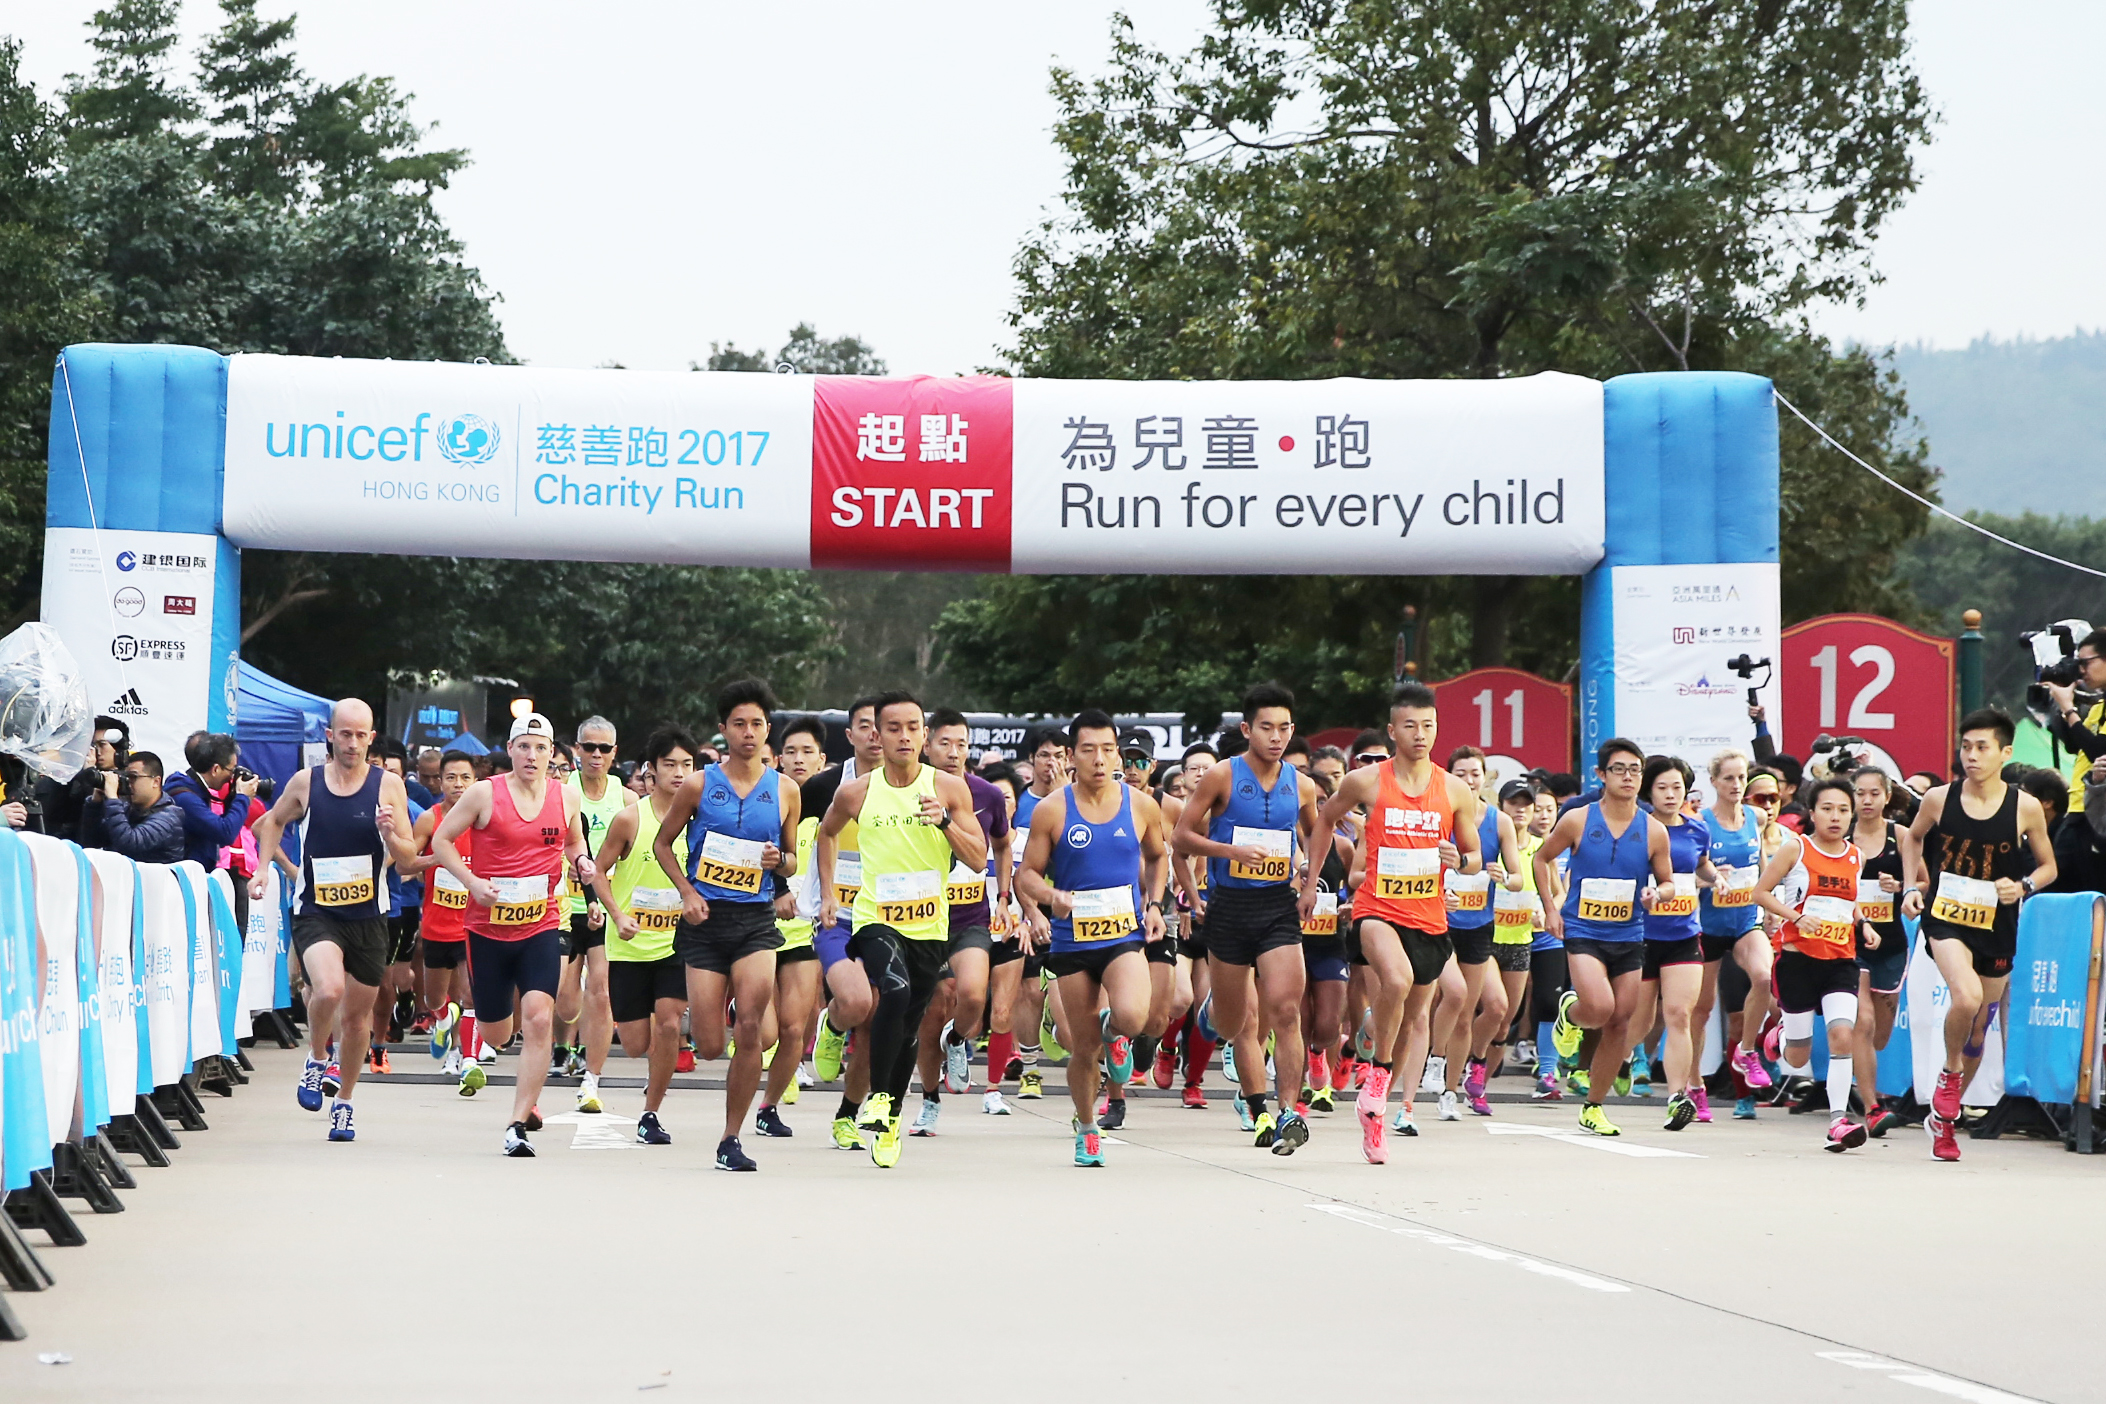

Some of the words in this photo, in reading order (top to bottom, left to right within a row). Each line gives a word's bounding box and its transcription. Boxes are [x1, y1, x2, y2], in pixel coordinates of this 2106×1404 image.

[266, 411, 431, 461] unicef
[856, 412, 969, 463] 起點
[363, 481, 428, 500] HONG
[437, 483, 500, 503] KONG
[534, 473, 664, 515] Charity
[675, 477, 744, 509] Run
[831, 486, 994, 528] START
[1061, 483, 1161, 528] Run
[1181, 482, 1258, 528] for
[1276, 493, 1424, 537] every
[1443, 478, 1564, 525] child
[141, 553, 207, 568] 建银国际
[1672, 595, 1693, 603] ASIA
[140, 640, 186, 650] EXPRESS
[1810, 644, 1896, 730] 12
[108, 704, 149, 715] adidas
[1472, 689, 1524, 748] 11
[541, 827, 559, 836] SUB
[703, 861, 756, 888] T2224
[318, 883, 370, 902] T3039
[1381, 878, 1434, 894] T2142
[494, 903, 543, 922] T2044
[881, 901, 936, 921] T2140
[1584, 901, 1629, 918] T2106
[1940, 901, 1987, 924] T2111
[634, 911, 680, 928] T1016
[1077, 917, 1133, 936] T2214
